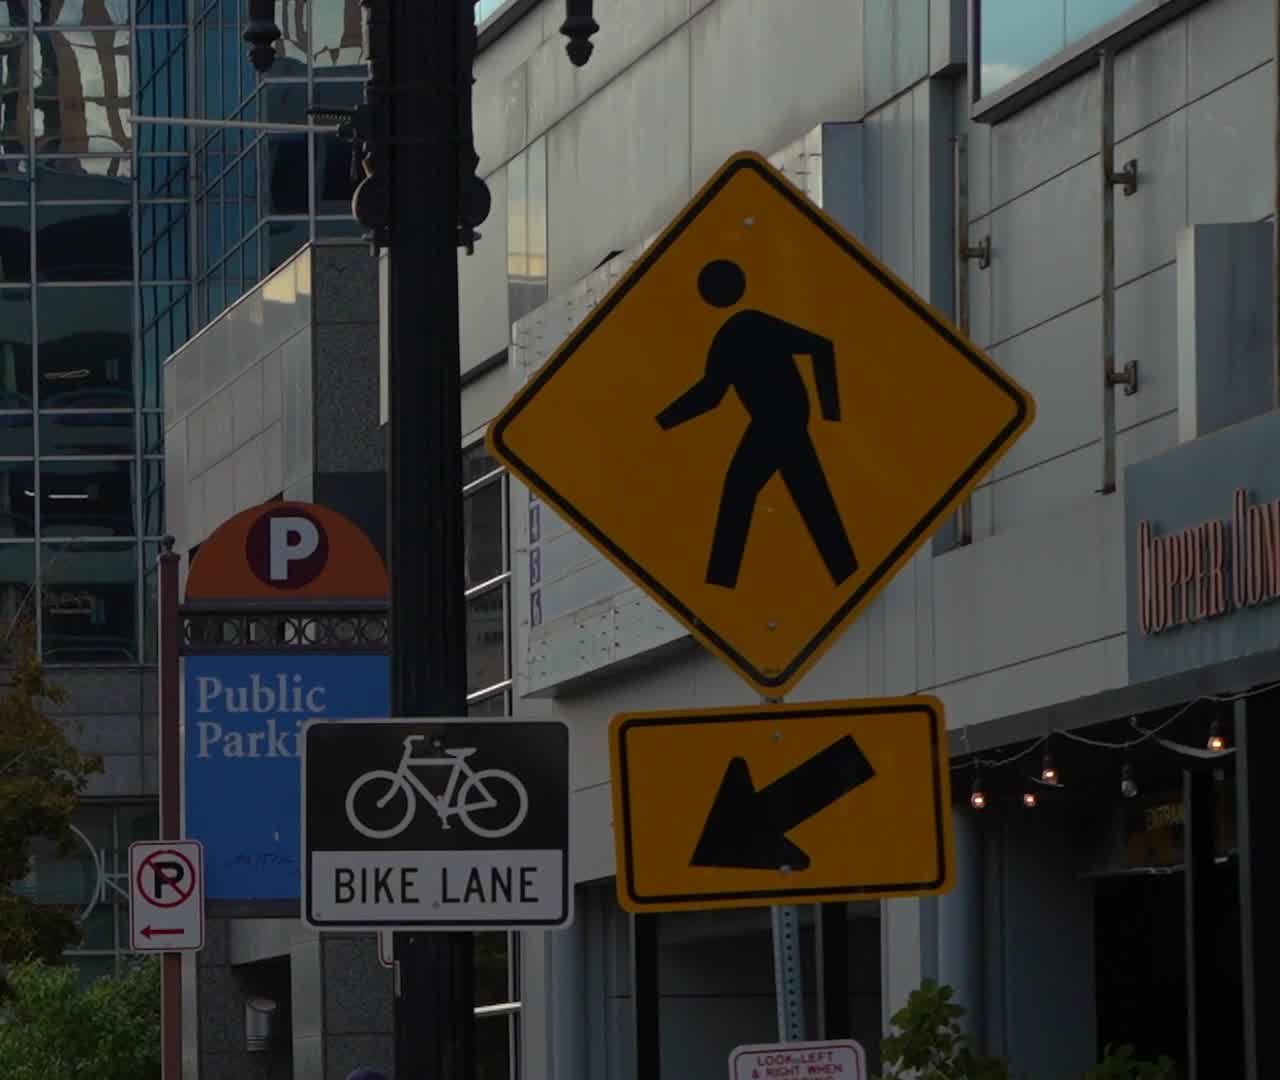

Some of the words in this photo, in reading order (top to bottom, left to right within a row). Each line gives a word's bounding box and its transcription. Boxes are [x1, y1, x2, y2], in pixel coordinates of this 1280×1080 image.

[269, 516, 320, 582] P
[1137, 519, 1227, 636] COPPER
[195, 672, 328, 714] Public
[195, 719, 302, 760] Parki
[334, 867, 420, 905] BIKE
[440, 865, 540, 904] LANE
[757, 1054, 793, 1066] LOOK
[800, 1051, 834, 1064] LEFT
[765, 1065, 800, 1077] RIGHT
[807, 1062, 843, 1074] WHEN
